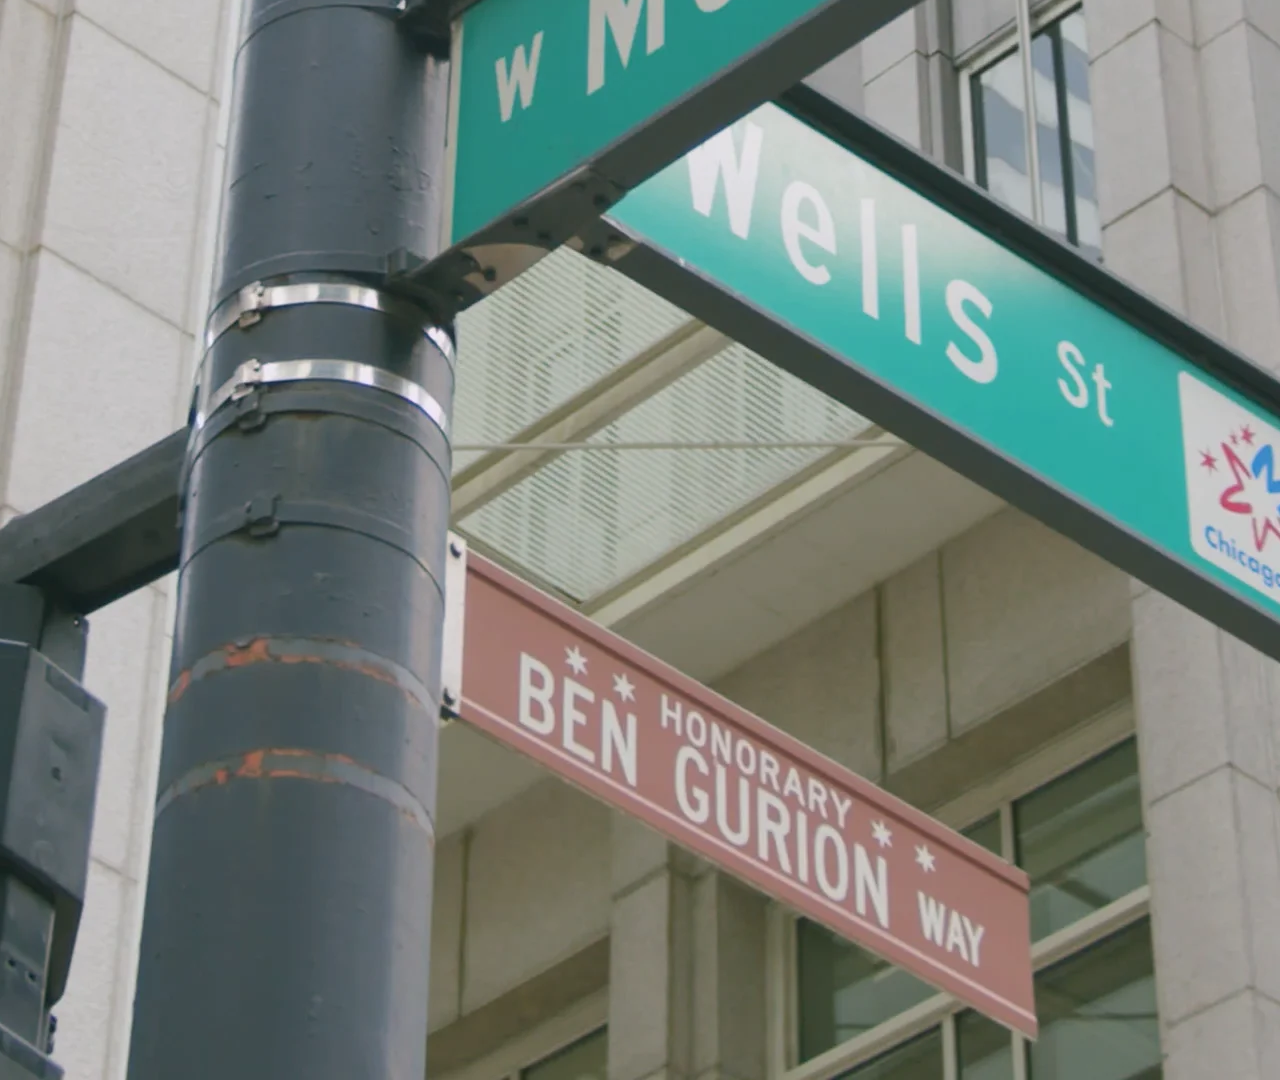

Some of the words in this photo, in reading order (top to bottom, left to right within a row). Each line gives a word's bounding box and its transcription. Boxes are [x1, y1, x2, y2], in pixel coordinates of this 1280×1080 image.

[494, 30, 544, 124] W
[685, 118, 999, 384] Wells
[1056, 340, 1114, 427] St
[520, 651, 638, 787] BEN
[675, 747, 890, 929] GURION
[917, 890, 985, 968] WAY
[660, 693, 852, 828] HONORARY
